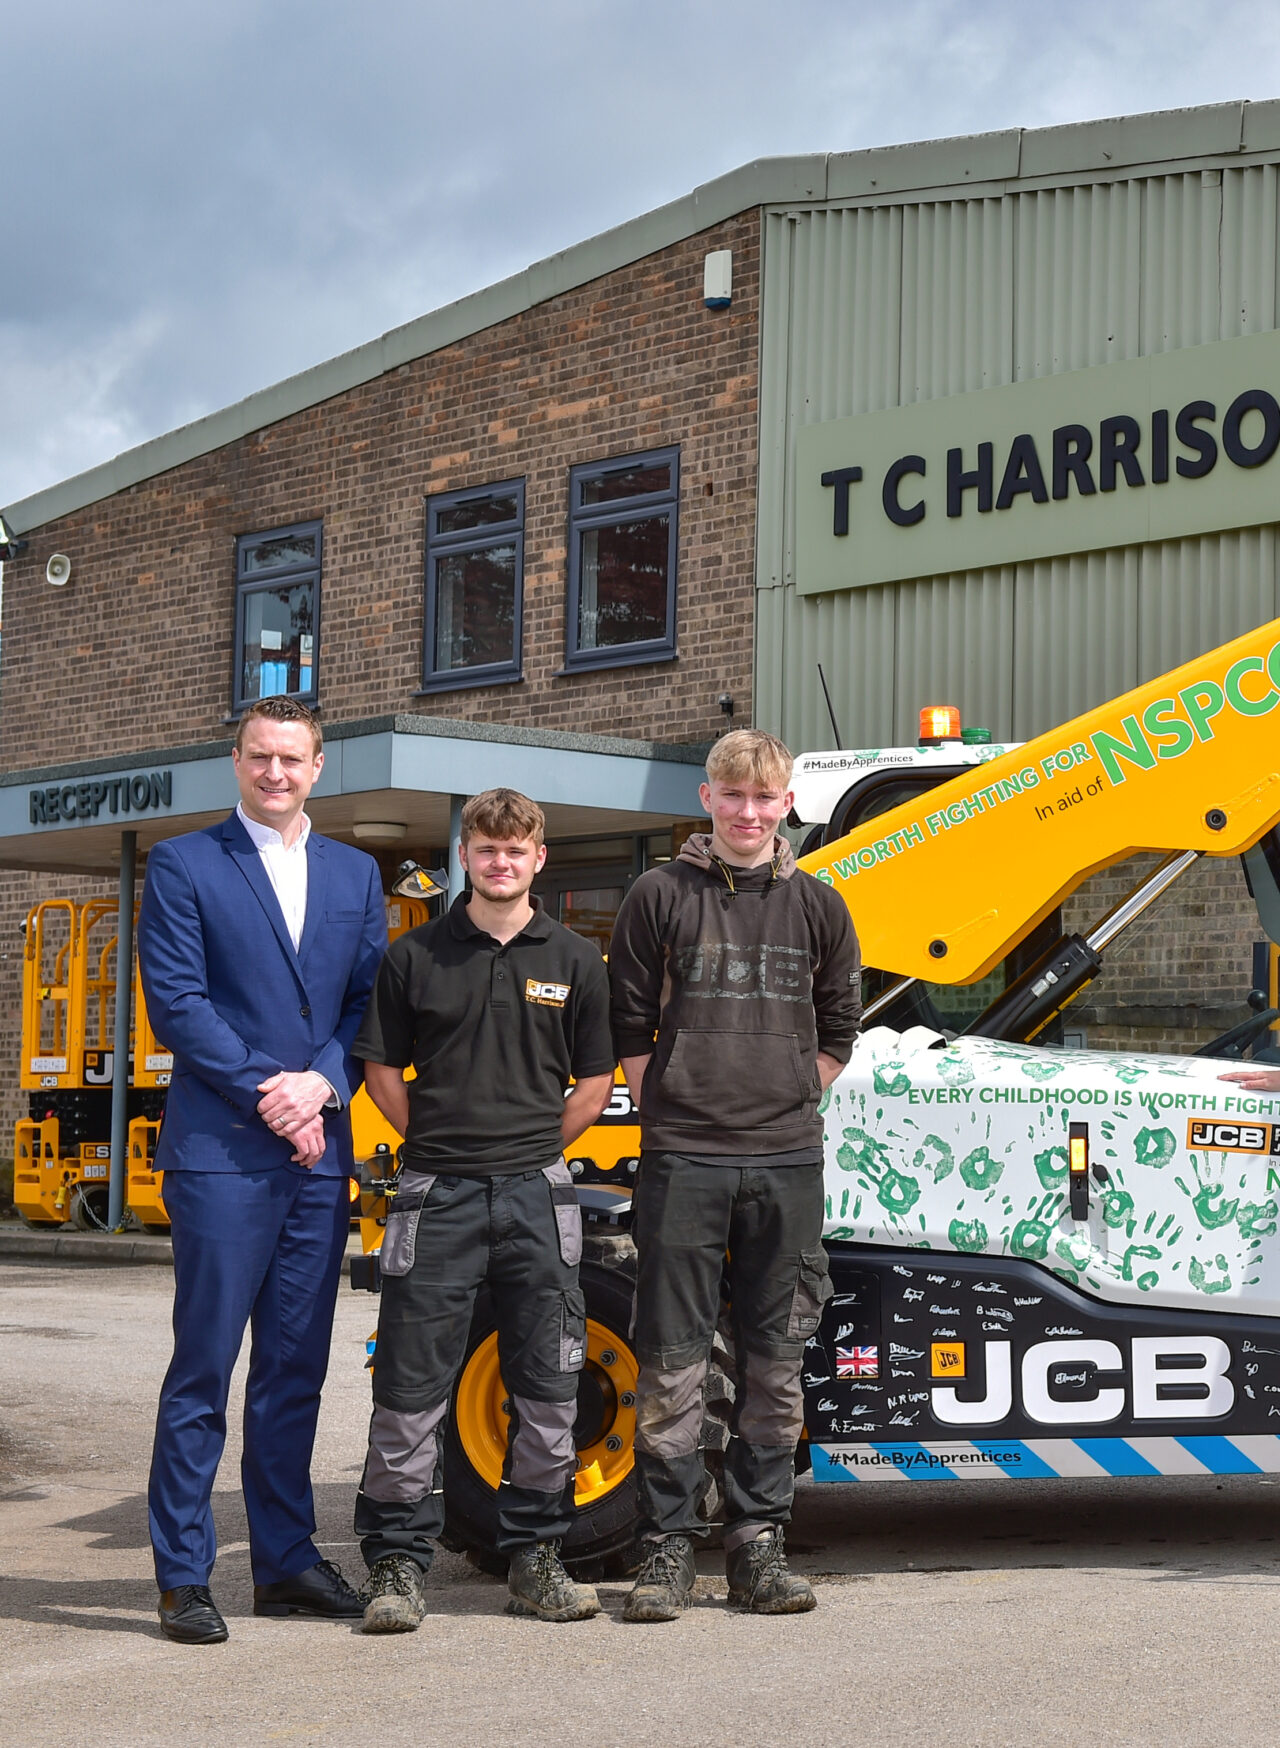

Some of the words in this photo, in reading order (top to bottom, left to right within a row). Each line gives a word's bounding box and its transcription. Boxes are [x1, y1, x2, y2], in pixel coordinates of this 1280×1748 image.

[821, 466, 863, 537] T
[882, 454, 927, 527] C
[803, 755, 914, 770] #MadeByApprentices
[29, 770, 172, 824] RECEPTION
[1034, 803, 1055, 822] In
[1057, 787, 1084, 812] aid
[1086, 775, 1105, 796] of
[834, 822, 925, 880] WORTH
[925, 767, 1040, 836] FIGHTING
[1041, 742, 1092, 780] FOR
[528, 983, 569, 1000] JCB
[40, 1076, 58, 1087] JCB
[908, 1088, 974, 1105] EVERY
[979, 1087, 1108, 1106] CHILDHOOD
[1114, 1090, 1132, 1107] IS
[1138, 1091, 1217, 1112] WORTH
[1193, 1124, 1264, 1148] JCB
[1269, 1158, 1277, 1166] In
[940, 1352, 958, 1368] JCB
[931, 1336, 1235, 1425] JCB
[828, 1450, 1021, 1468] #MadeByApprentices
